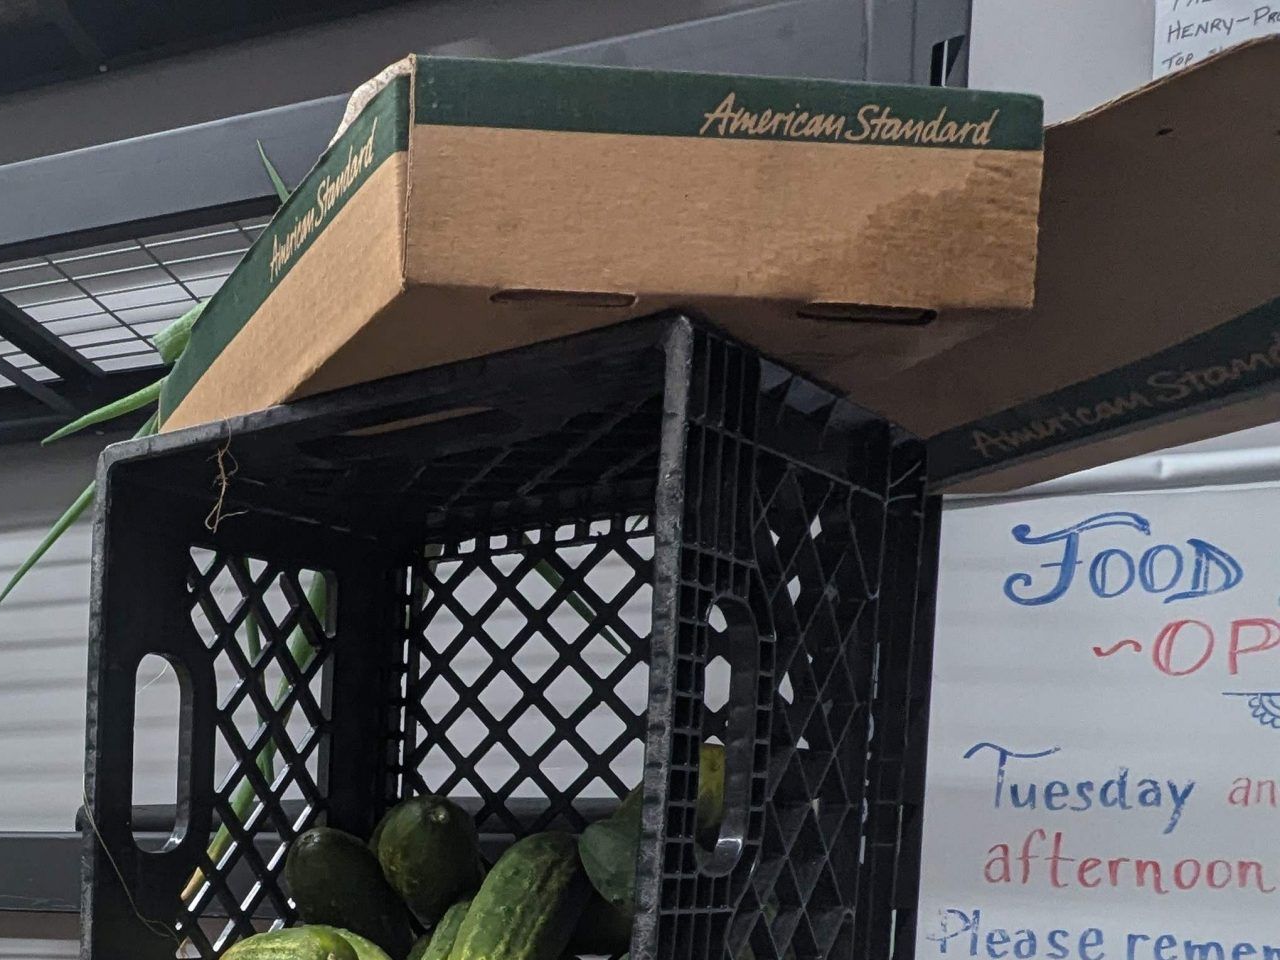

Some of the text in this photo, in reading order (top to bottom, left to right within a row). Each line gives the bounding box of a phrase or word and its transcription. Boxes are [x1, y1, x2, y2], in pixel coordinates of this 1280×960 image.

[699, 92, 1001, 147] American Standard
[270, 117, 378, 283] American Standard
[971, 391, 1153, 457] American
[963, 742, 1196, 835] Tuesday
[984, 829, 1276, 894] afternoon
[926, 908, 1105, 960] Please
